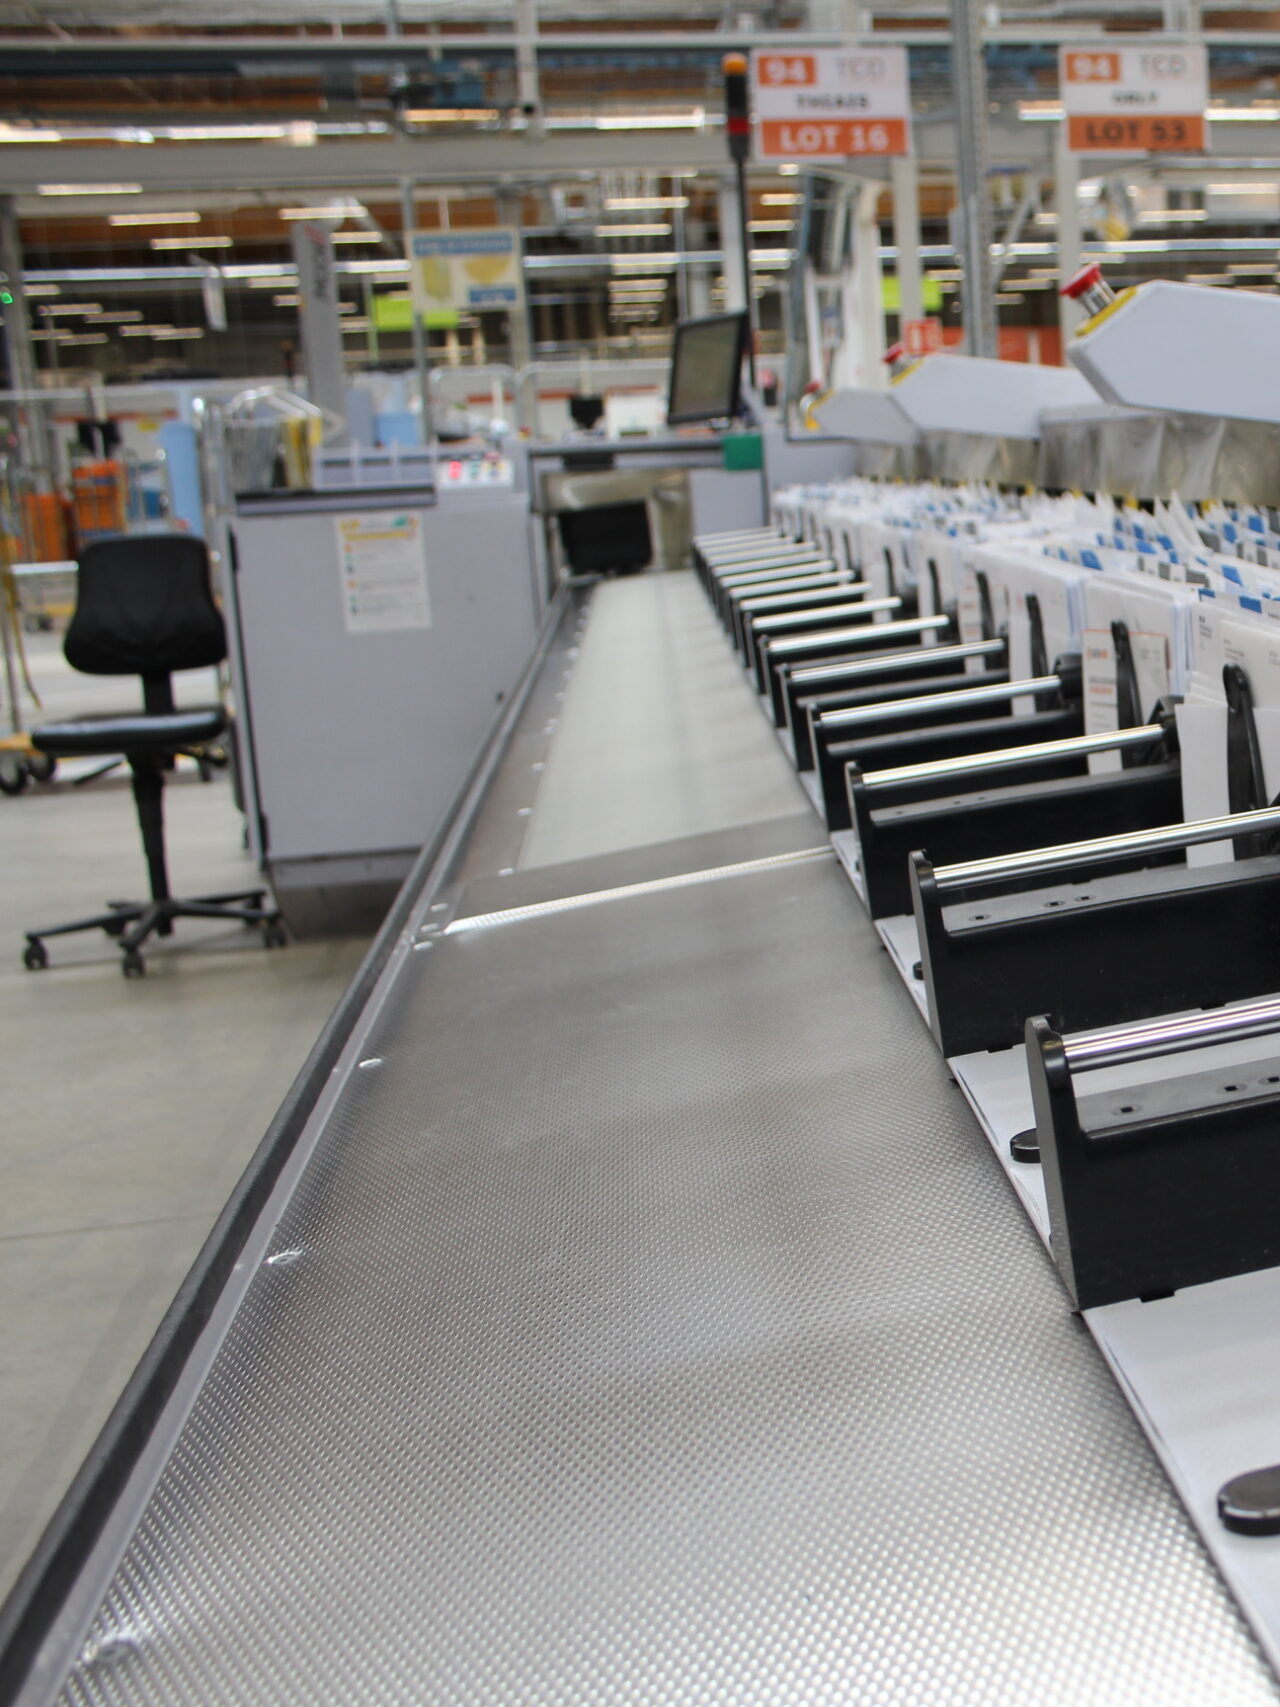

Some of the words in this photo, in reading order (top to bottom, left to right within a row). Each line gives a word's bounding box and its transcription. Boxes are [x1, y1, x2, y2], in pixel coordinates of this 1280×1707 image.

[766, 58, 807, 83] 94
[836, 57, 887, 80] TCD
[1074, 55, 1112, 80] 94
[1139, 54, 1188, 78] TCD
[780, 124, 843, 152] LOT
[852, 124, 889, 152] 16
[1086, 120, 1140, 144] LOT
[1152, 120, 1188, 144] 53
